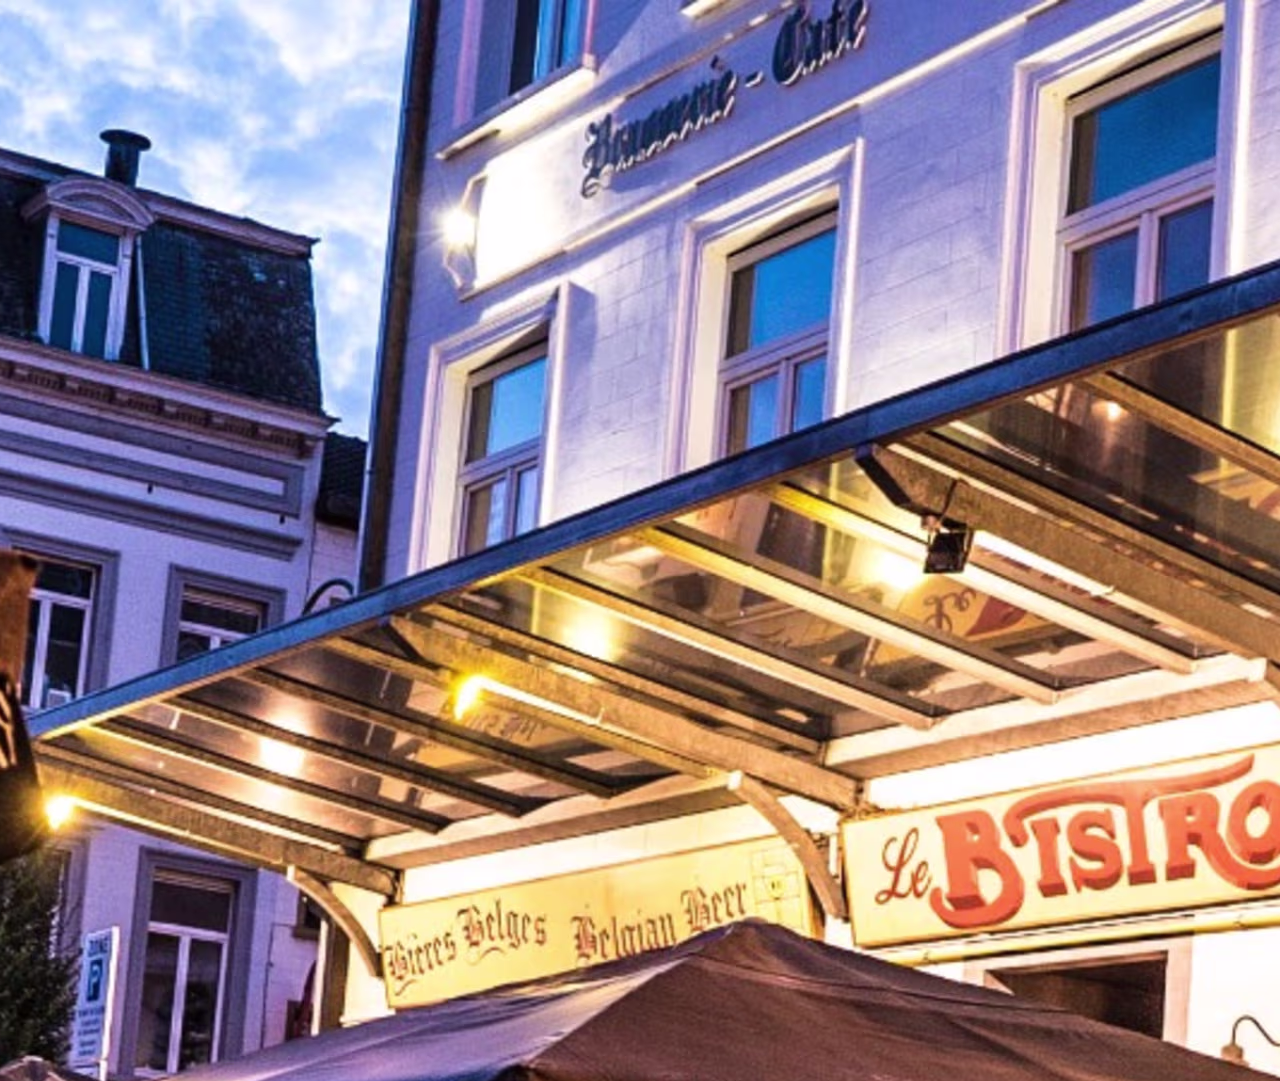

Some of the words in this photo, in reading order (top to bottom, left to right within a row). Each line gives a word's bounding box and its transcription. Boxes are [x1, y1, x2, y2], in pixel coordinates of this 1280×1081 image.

[875, 827, 932, 904] Le
[456, 897, 548, 966] Belges
[680, 880, 748, 932] Beer
